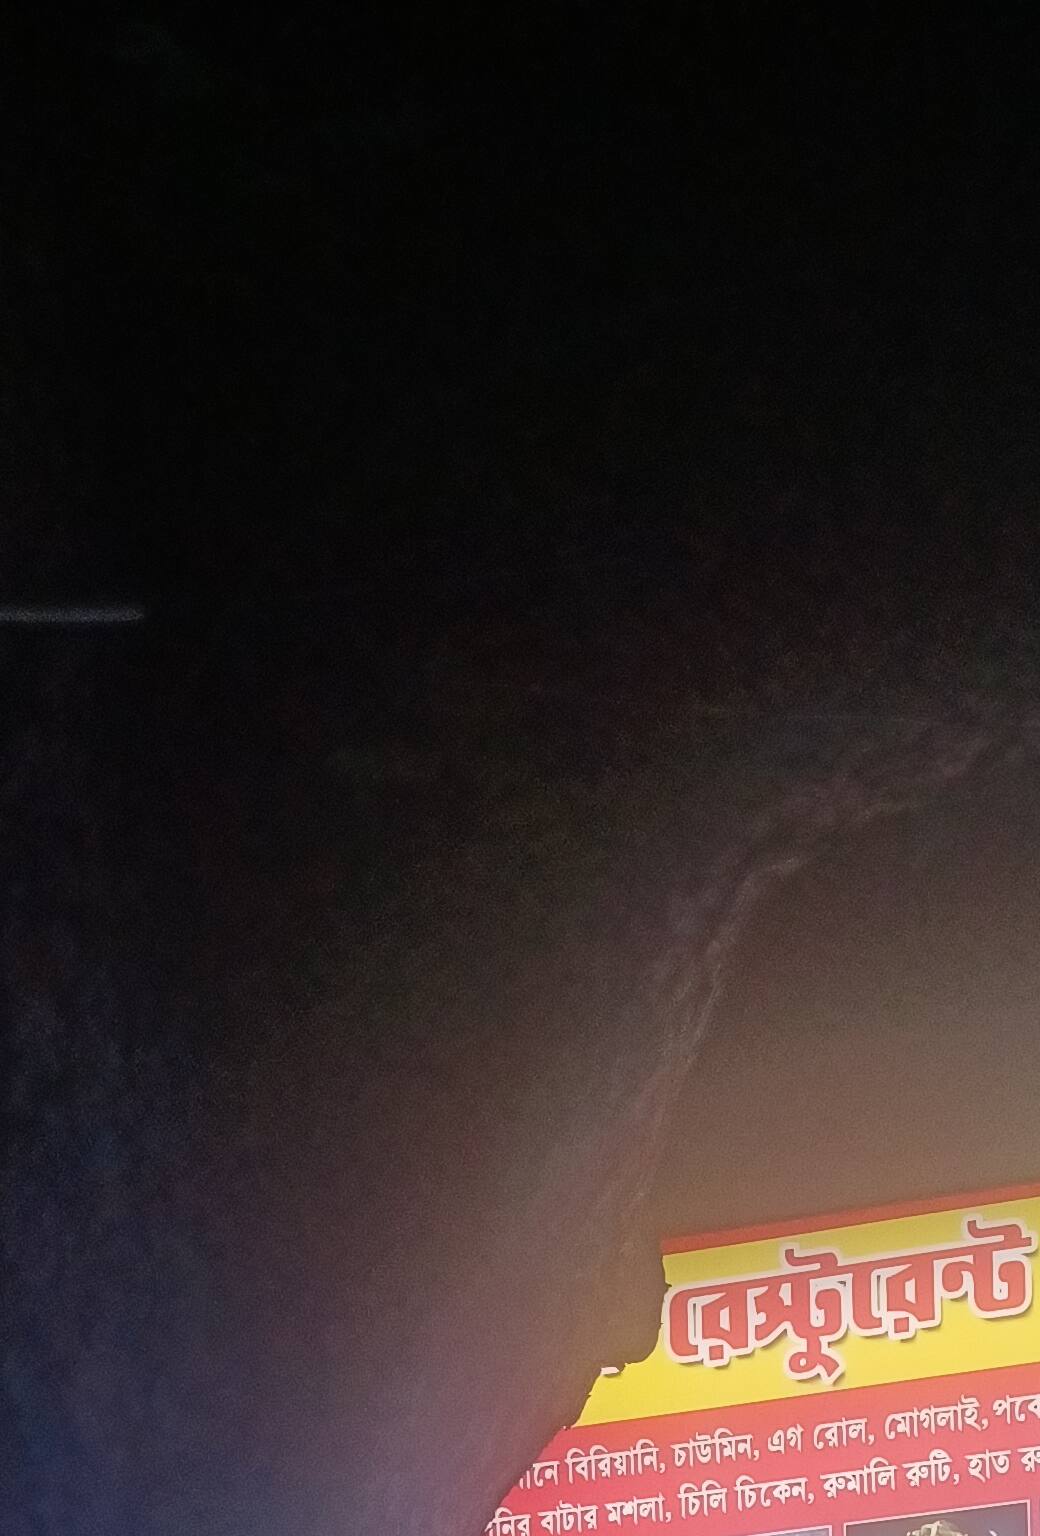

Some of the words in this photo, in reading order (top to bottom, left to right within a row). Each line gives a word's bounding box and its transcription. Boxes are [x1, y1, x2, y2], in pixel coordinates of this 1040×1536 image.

[667, 1219, 1034, 1379] রেস্টুরেন্ট
[563, 1438, 666, 1485] বিরিয়ানি,
[671, 1427, 760, 1469] চাউমিন,
[767, 1423, 804, 1453] এগ
[813, 1415, 876, 1450] রোল,
[884, 1394, 989, 1440] মোগলাই,
[537, 1499, 599, 1535] বাটার
[605, 1495, 672, 1526] মশলা,
[678, 1482, 728, 1517] চিলি
[735, 1475, 815, 1511] চিকেন,
[821, 1456, 898, 1499] রুমালি
[903, 1448, 961, 1489] রুটি,
[966, 1448, 1012, 1483] হাত
